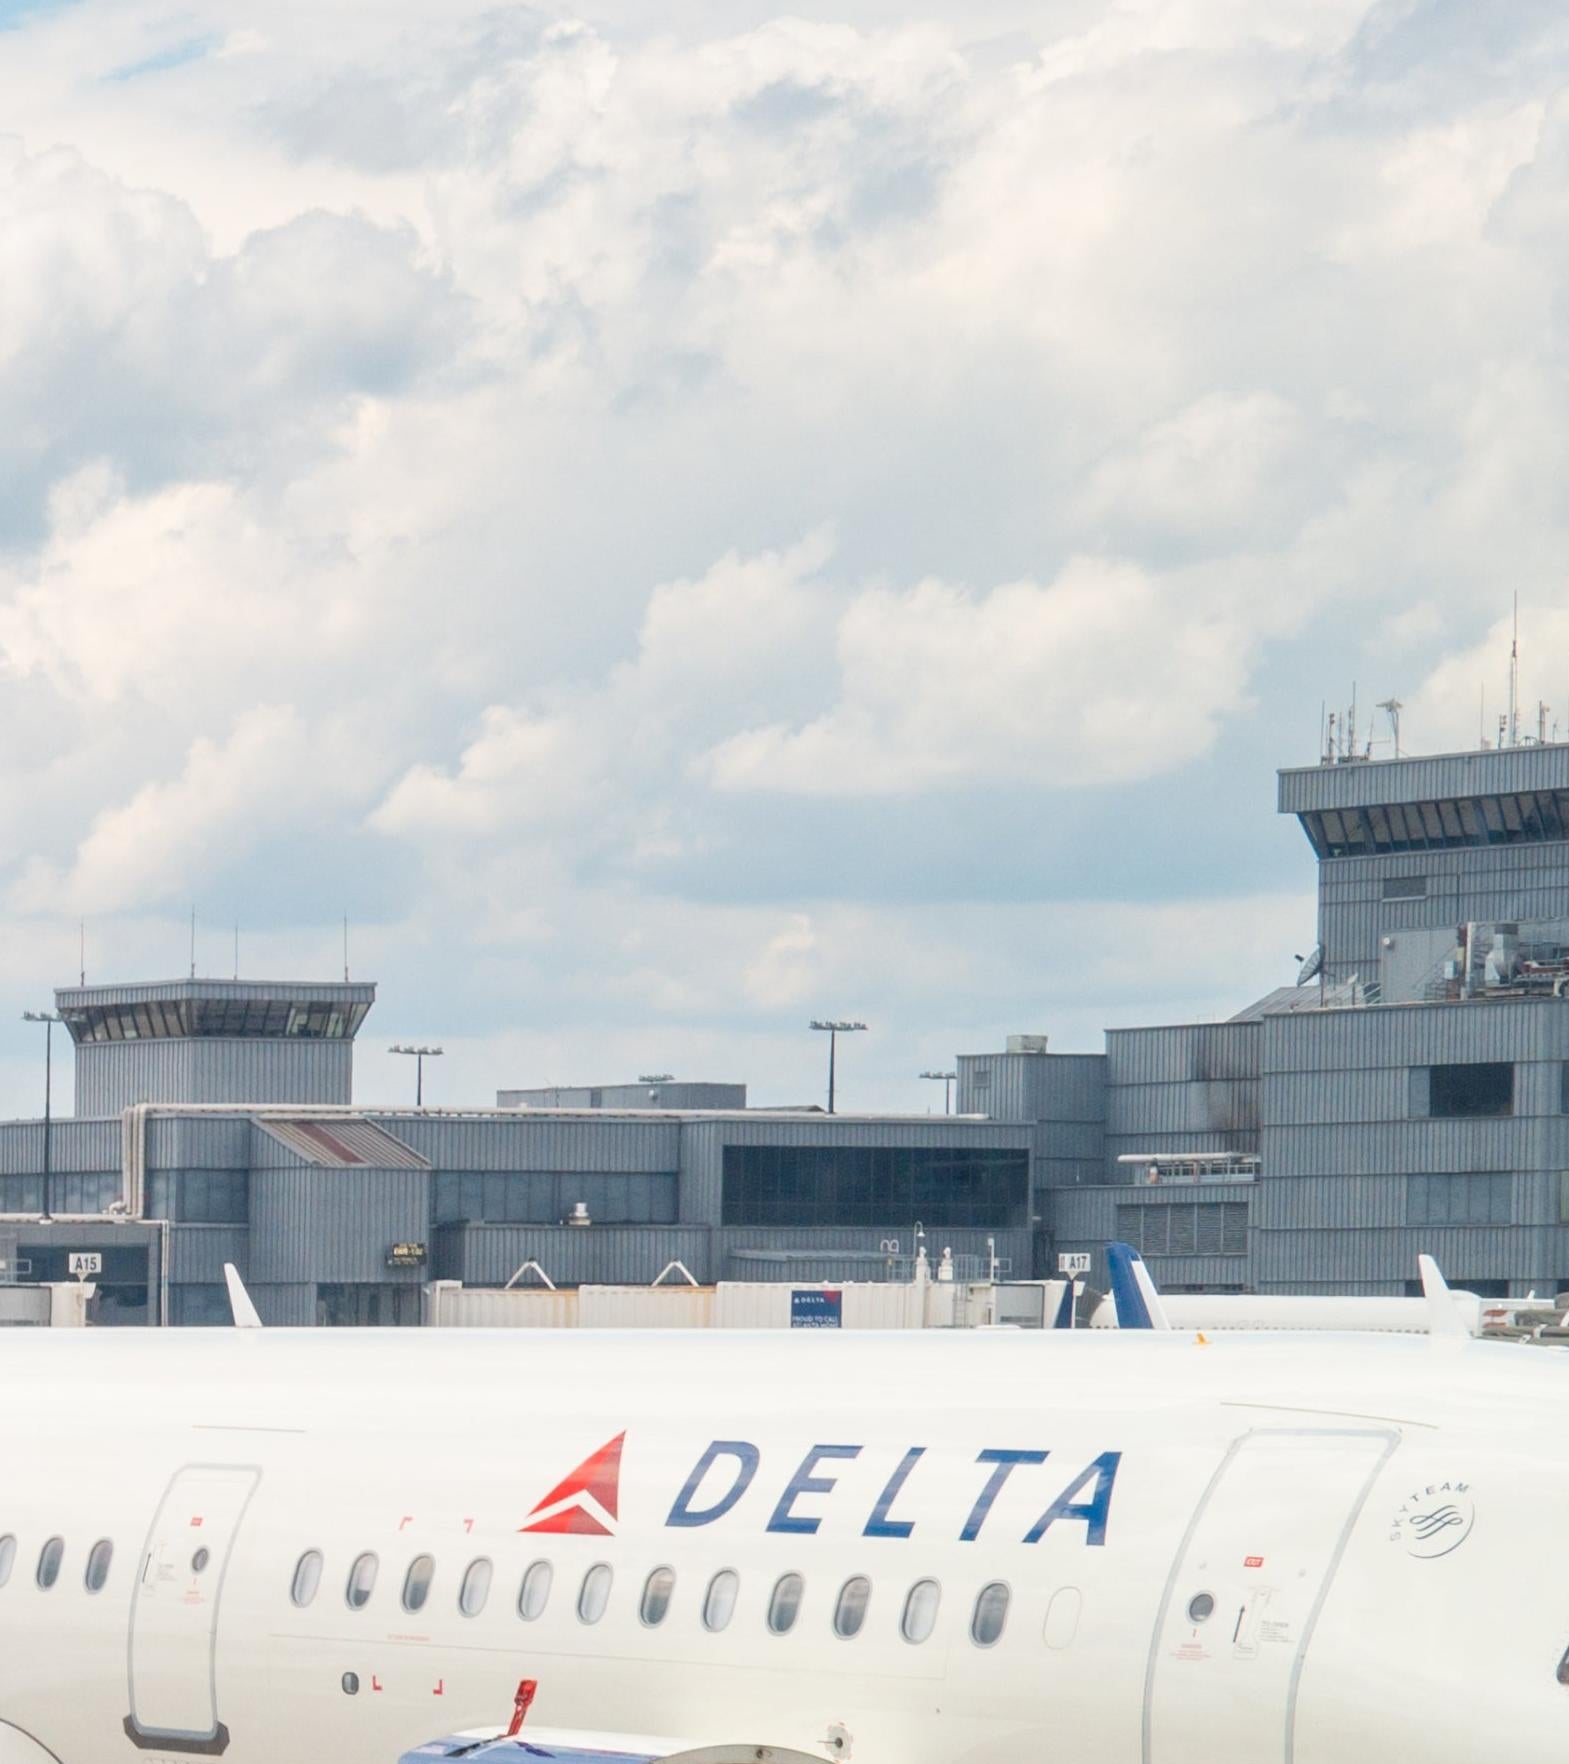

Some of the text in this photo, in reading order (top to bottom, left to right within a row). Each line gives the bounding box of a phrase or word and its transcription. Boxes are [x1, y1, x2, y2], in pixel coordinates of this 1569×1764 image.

[75, 1256, 97, 1270] A15
[1069, 1256, 1087, 1269] A17
[666, 1440, 1122, 1546] DELTA
[1390, 1481, 1470, 1541] SKYTEAM
